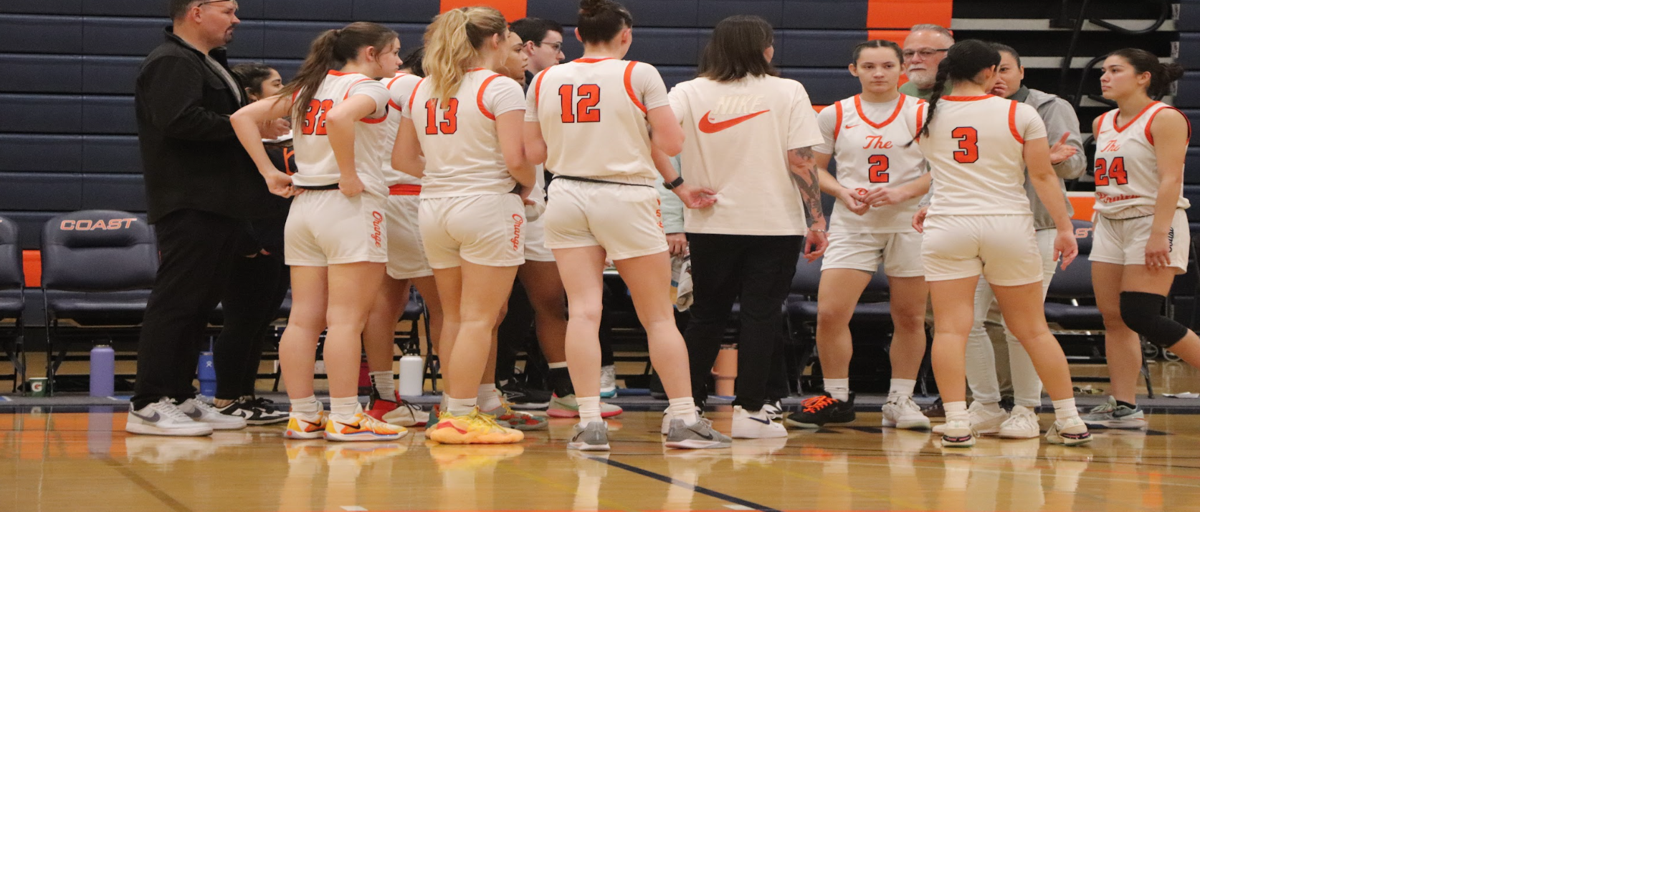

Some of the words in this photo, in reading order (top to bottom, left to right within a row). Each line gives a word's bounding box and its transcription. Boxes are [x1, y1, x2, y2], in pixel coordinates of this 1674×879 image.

[302, 98, 334, 135] 32
[425, 97, 459, 135] 13
[559, 84, 601, 123] 12
[711, 94, 766, 115] NIKE
[863, 135, 893, 150] The
[951, 126, 979, 163] 3
[1100, 139, 1121, 153] The
[868, 154, 889, 183] 2
[1094, 156, 1128, 186] 24
[60, 217, 138, 231] COAST
[371, 210, 383, 248] Orange
[511, 213, 524, 251] Orange
[31, 381, 43, 393] G
